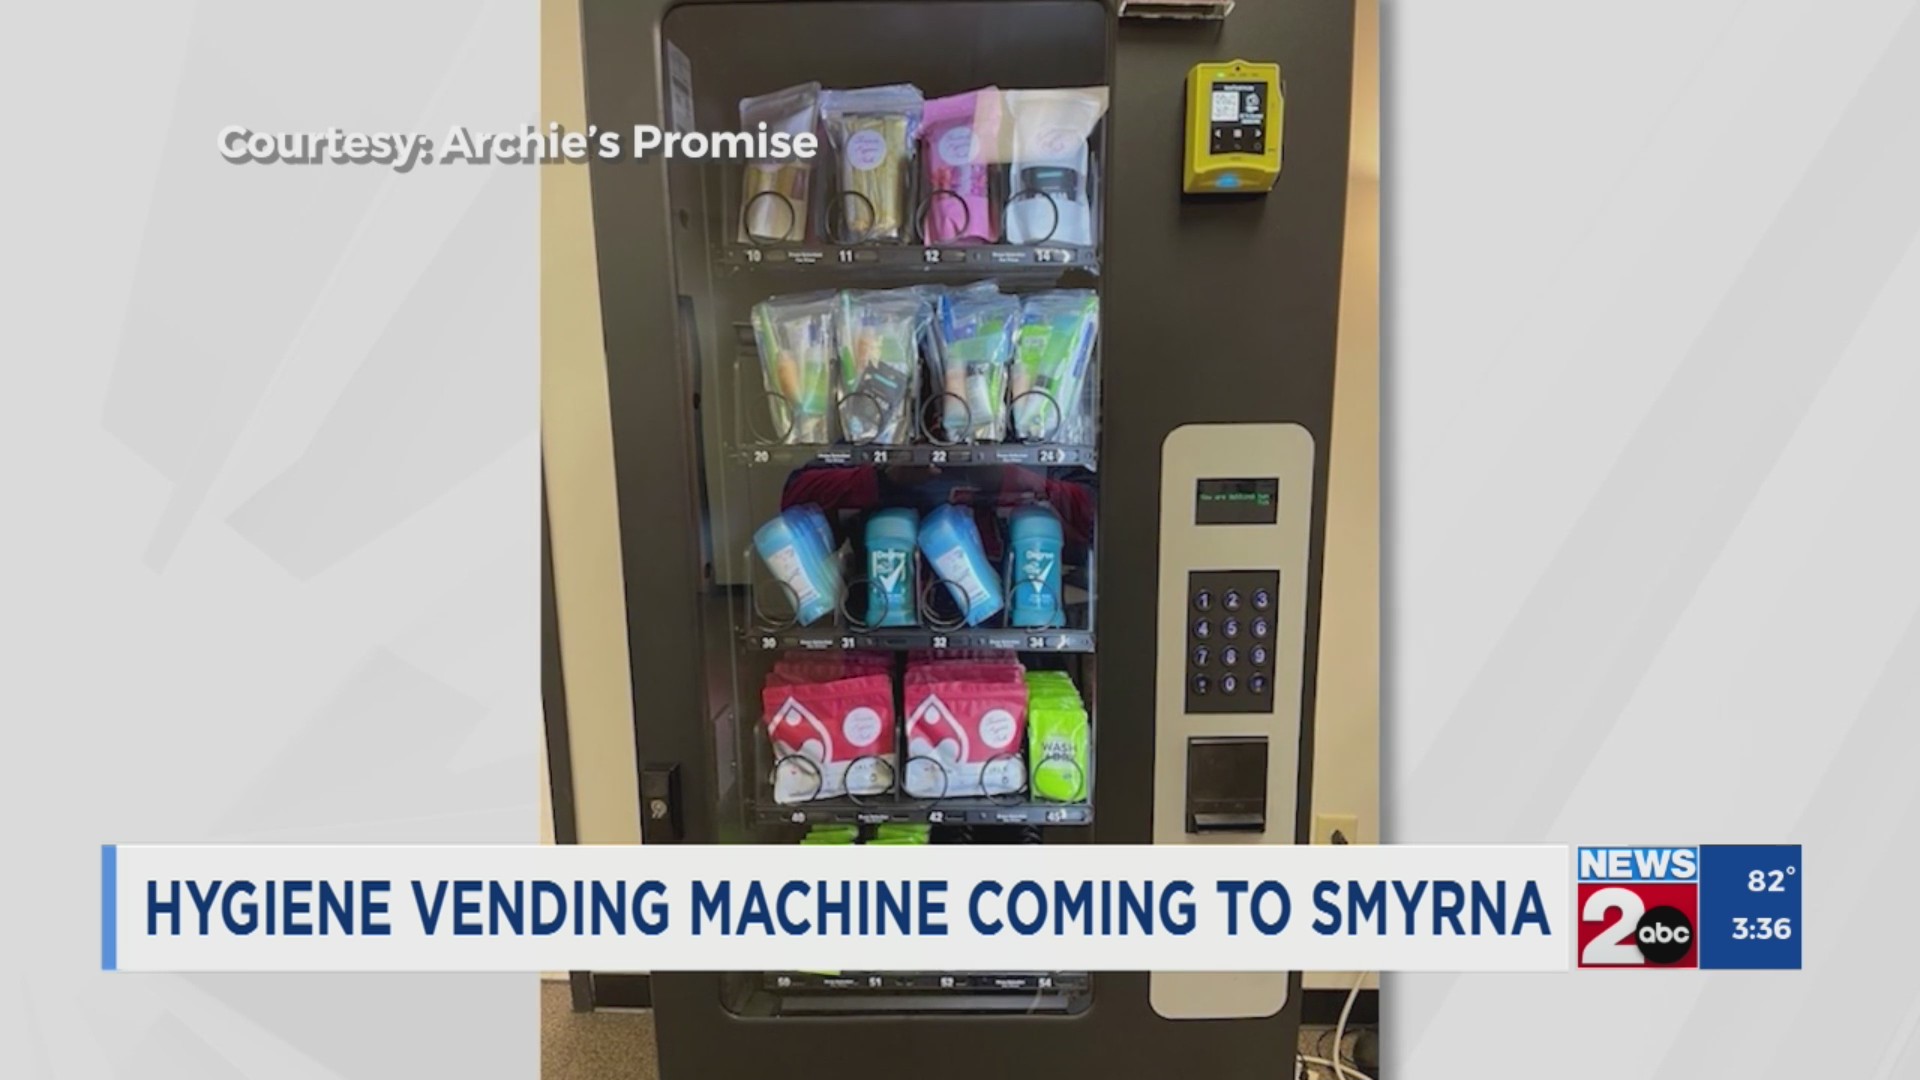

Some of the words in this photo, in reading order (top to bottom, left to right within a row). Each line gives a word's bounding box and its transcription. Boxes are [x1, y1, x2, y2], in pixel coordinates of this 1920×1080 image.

[839, 249, 853, 262] 11
[925, 249, 940, 262] 12
[754, 450, 769, 463] 20
[874, 450, 888, 463] 21
[932, 450, 947, 463] 22
[1200, 593, 1209, 608] 1
[1227, 592, 1238, 607] 2
[1256, 592, 1268, 607] 3
[1198, 621, 1209, 636] 4
[1227, 621, 1238, 636] 5
[1256, 621, 1267, 636] 6
[762, 636, 777, 649] 30
[841, 636, 856, 649] 31
[932, 636, 947, 649] 32
[1029, 636, 1044, 649] 34
[1198, 649, 1208, 664] 7
[1226, 649, 1237, 664] 8
[1254, 648, 1266, 663] 9
[1225, 677, 1236, 691] 0
[1042, 741, 1078, 753] WASH
[869, 976, 883, 988] 51
[1038, 976, 1053, 989] 54
